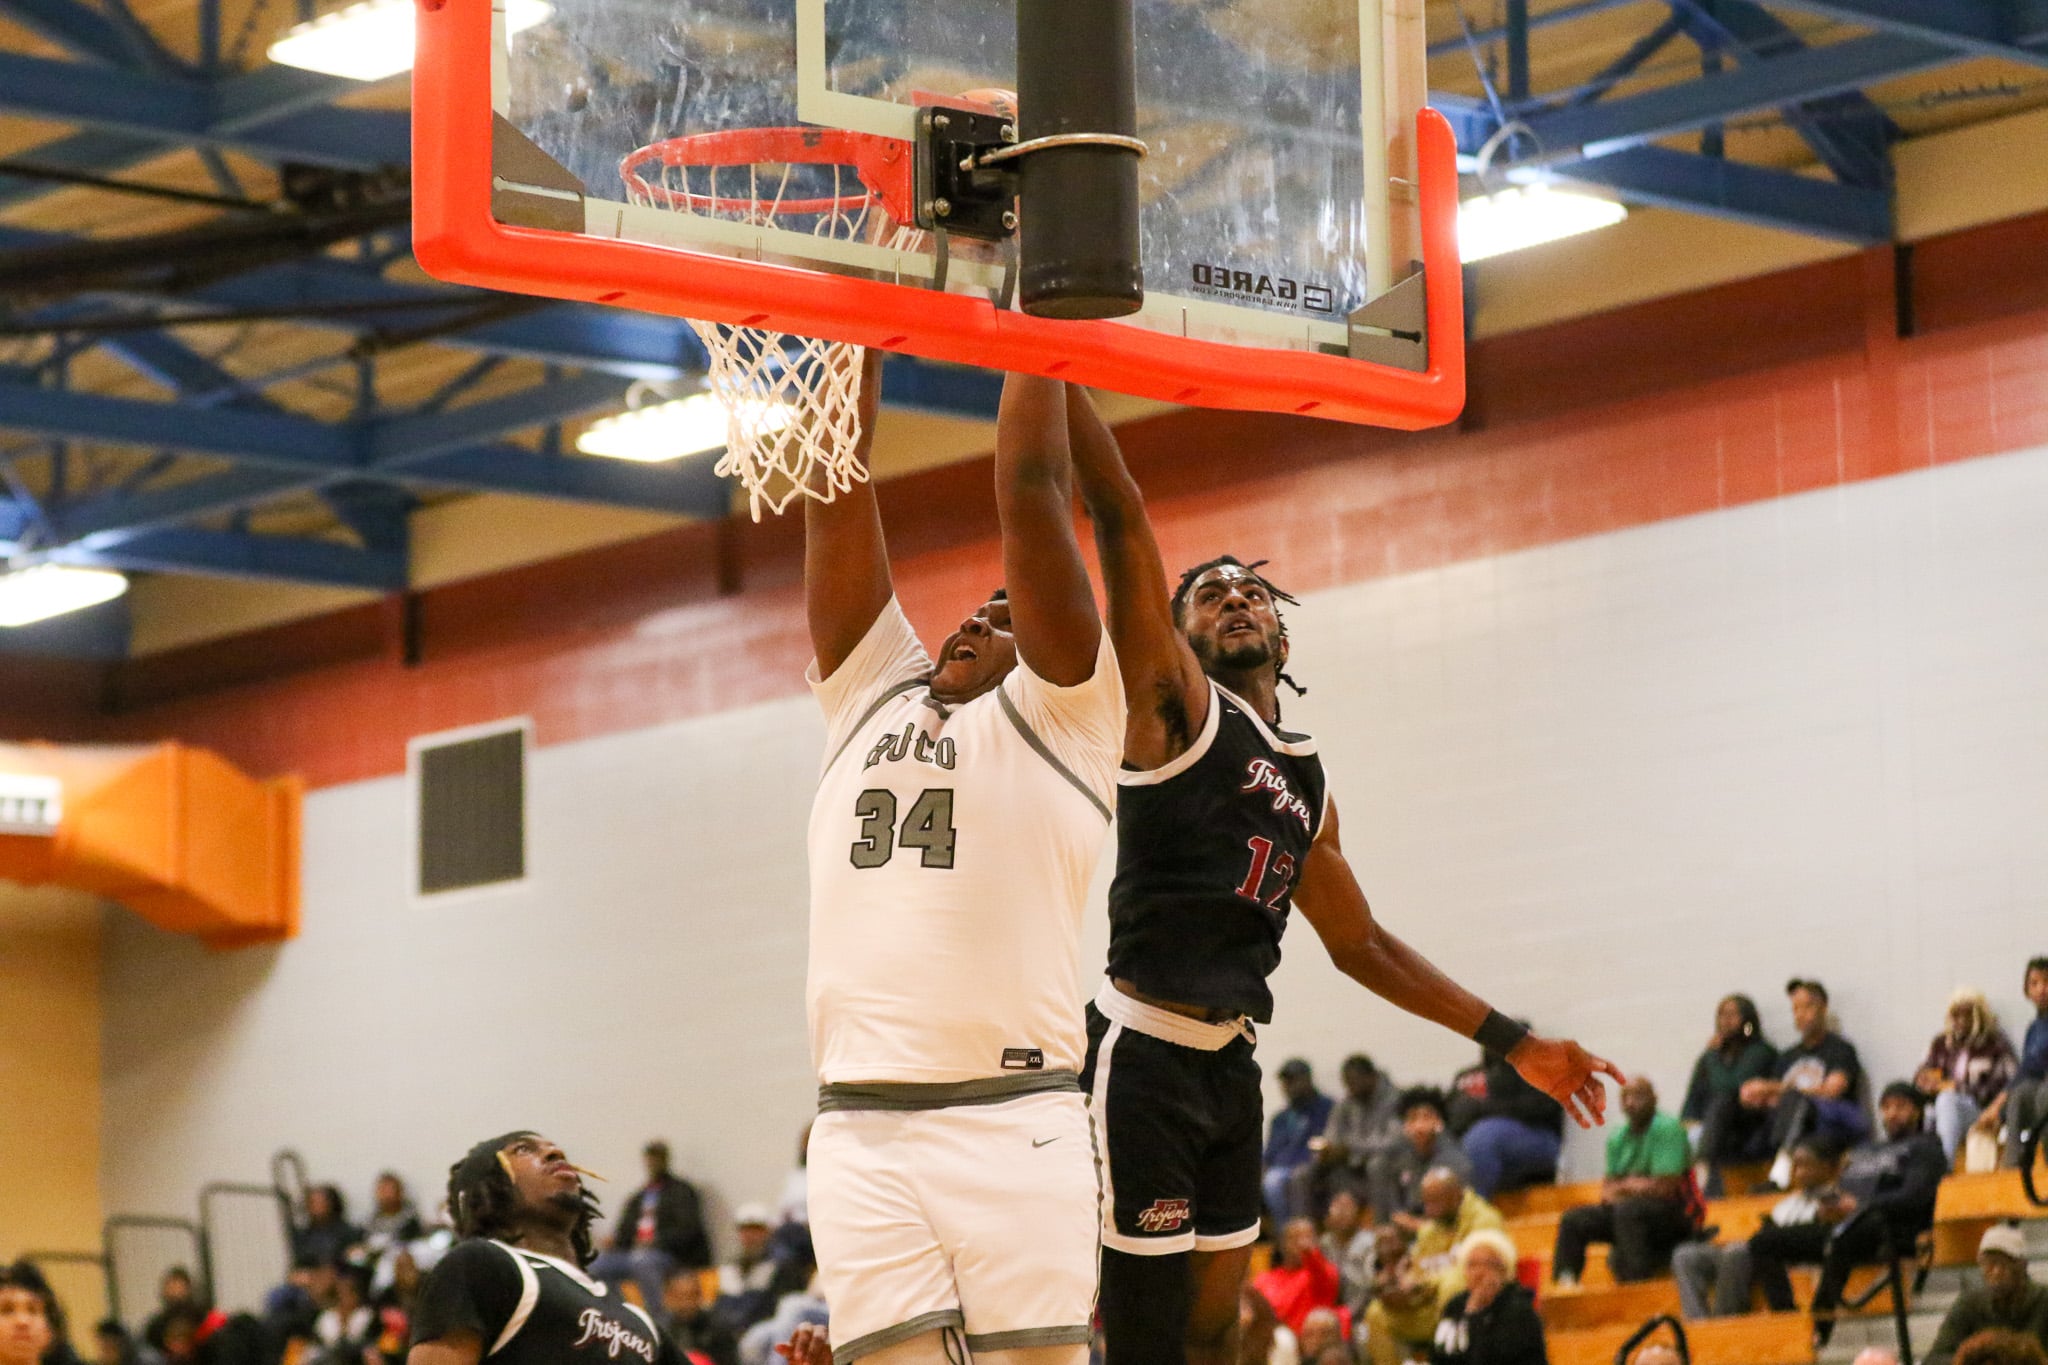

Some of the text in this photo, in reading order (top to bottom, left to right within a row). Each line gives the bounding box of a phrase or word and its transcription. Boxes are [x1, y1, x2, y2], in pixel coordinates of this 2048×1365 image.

[1241, 757, 1311, 832] Trojans
[849, 788, 957, 870] 34
[1234, 835, 1296, 911] 12
[1029, 1056, 1041, 1064] XXL
[1135, 1207, 1189, 1232] Trojans
[573, 1308, 653, 1363] Trojans
